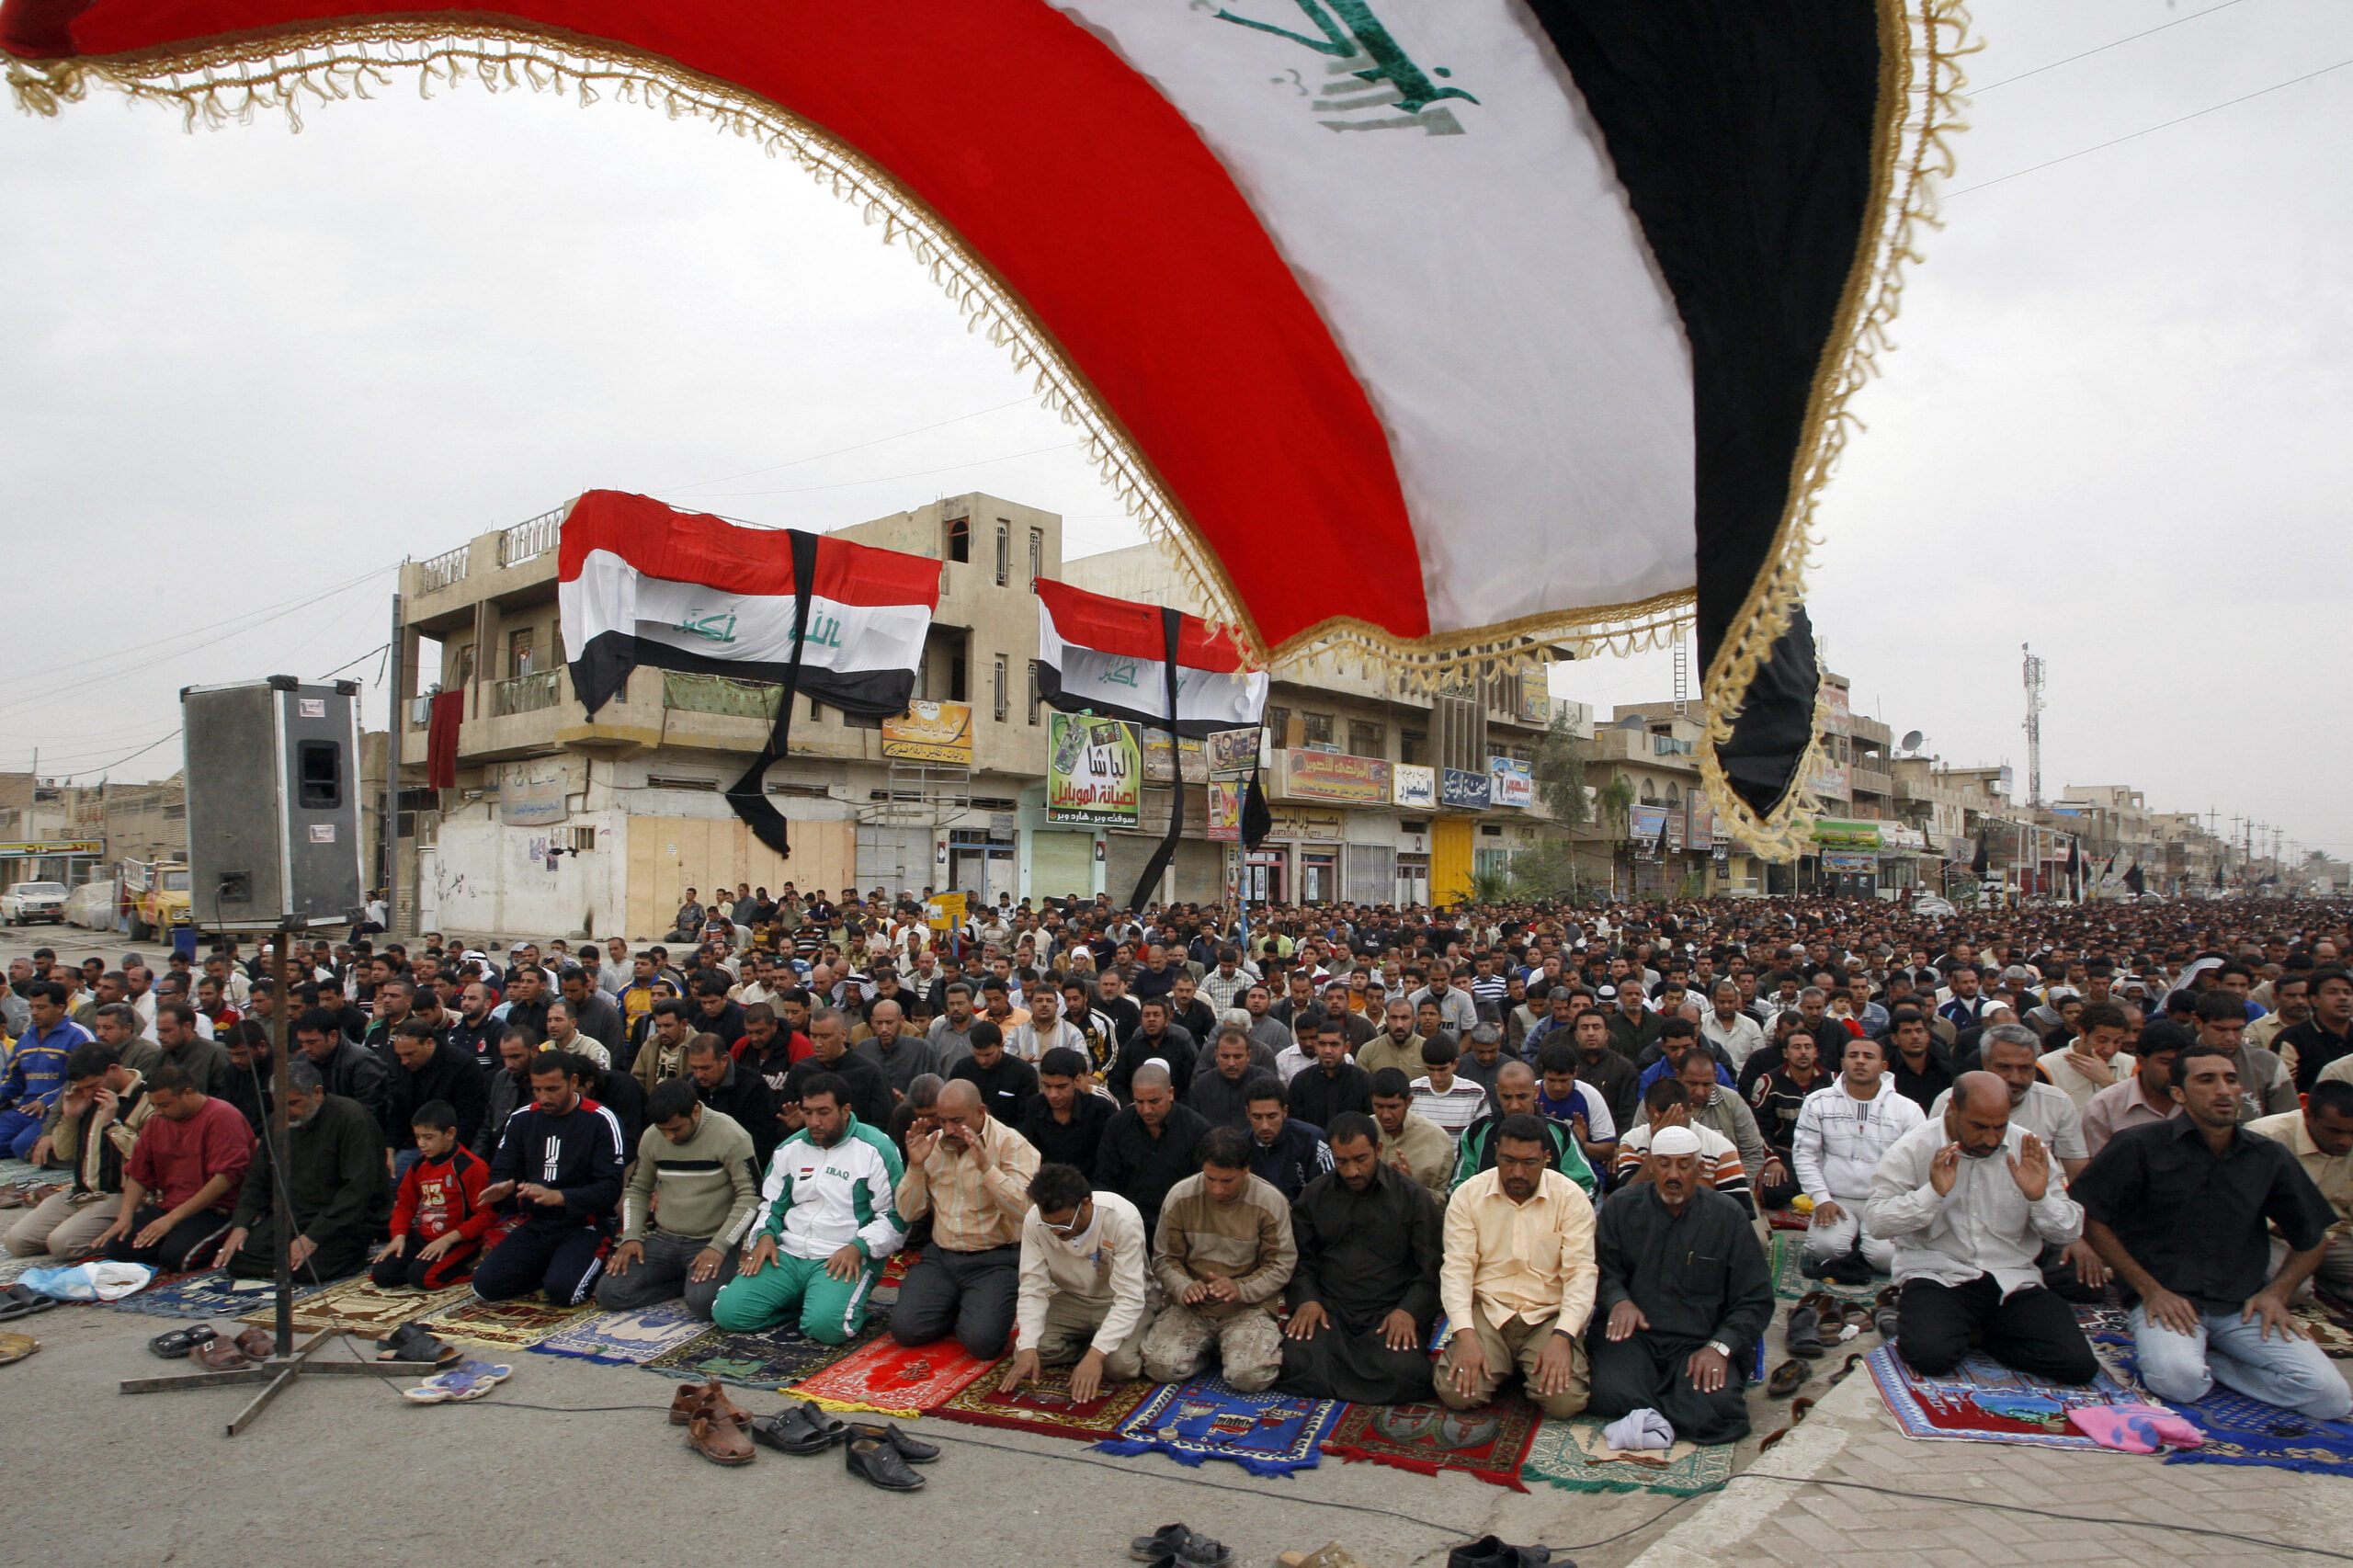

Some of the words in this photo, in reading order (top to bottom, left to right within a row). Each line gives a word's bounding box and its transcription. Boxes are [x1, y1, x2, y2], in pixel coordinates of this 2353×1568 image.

[1086, 744, 1134, 786] الباشا
[1051, 780, 1097, 807] الموبايل
[1098, 785, 1137, 809] لصيانة
[825, 1166, 850, 1181] IRAQ
